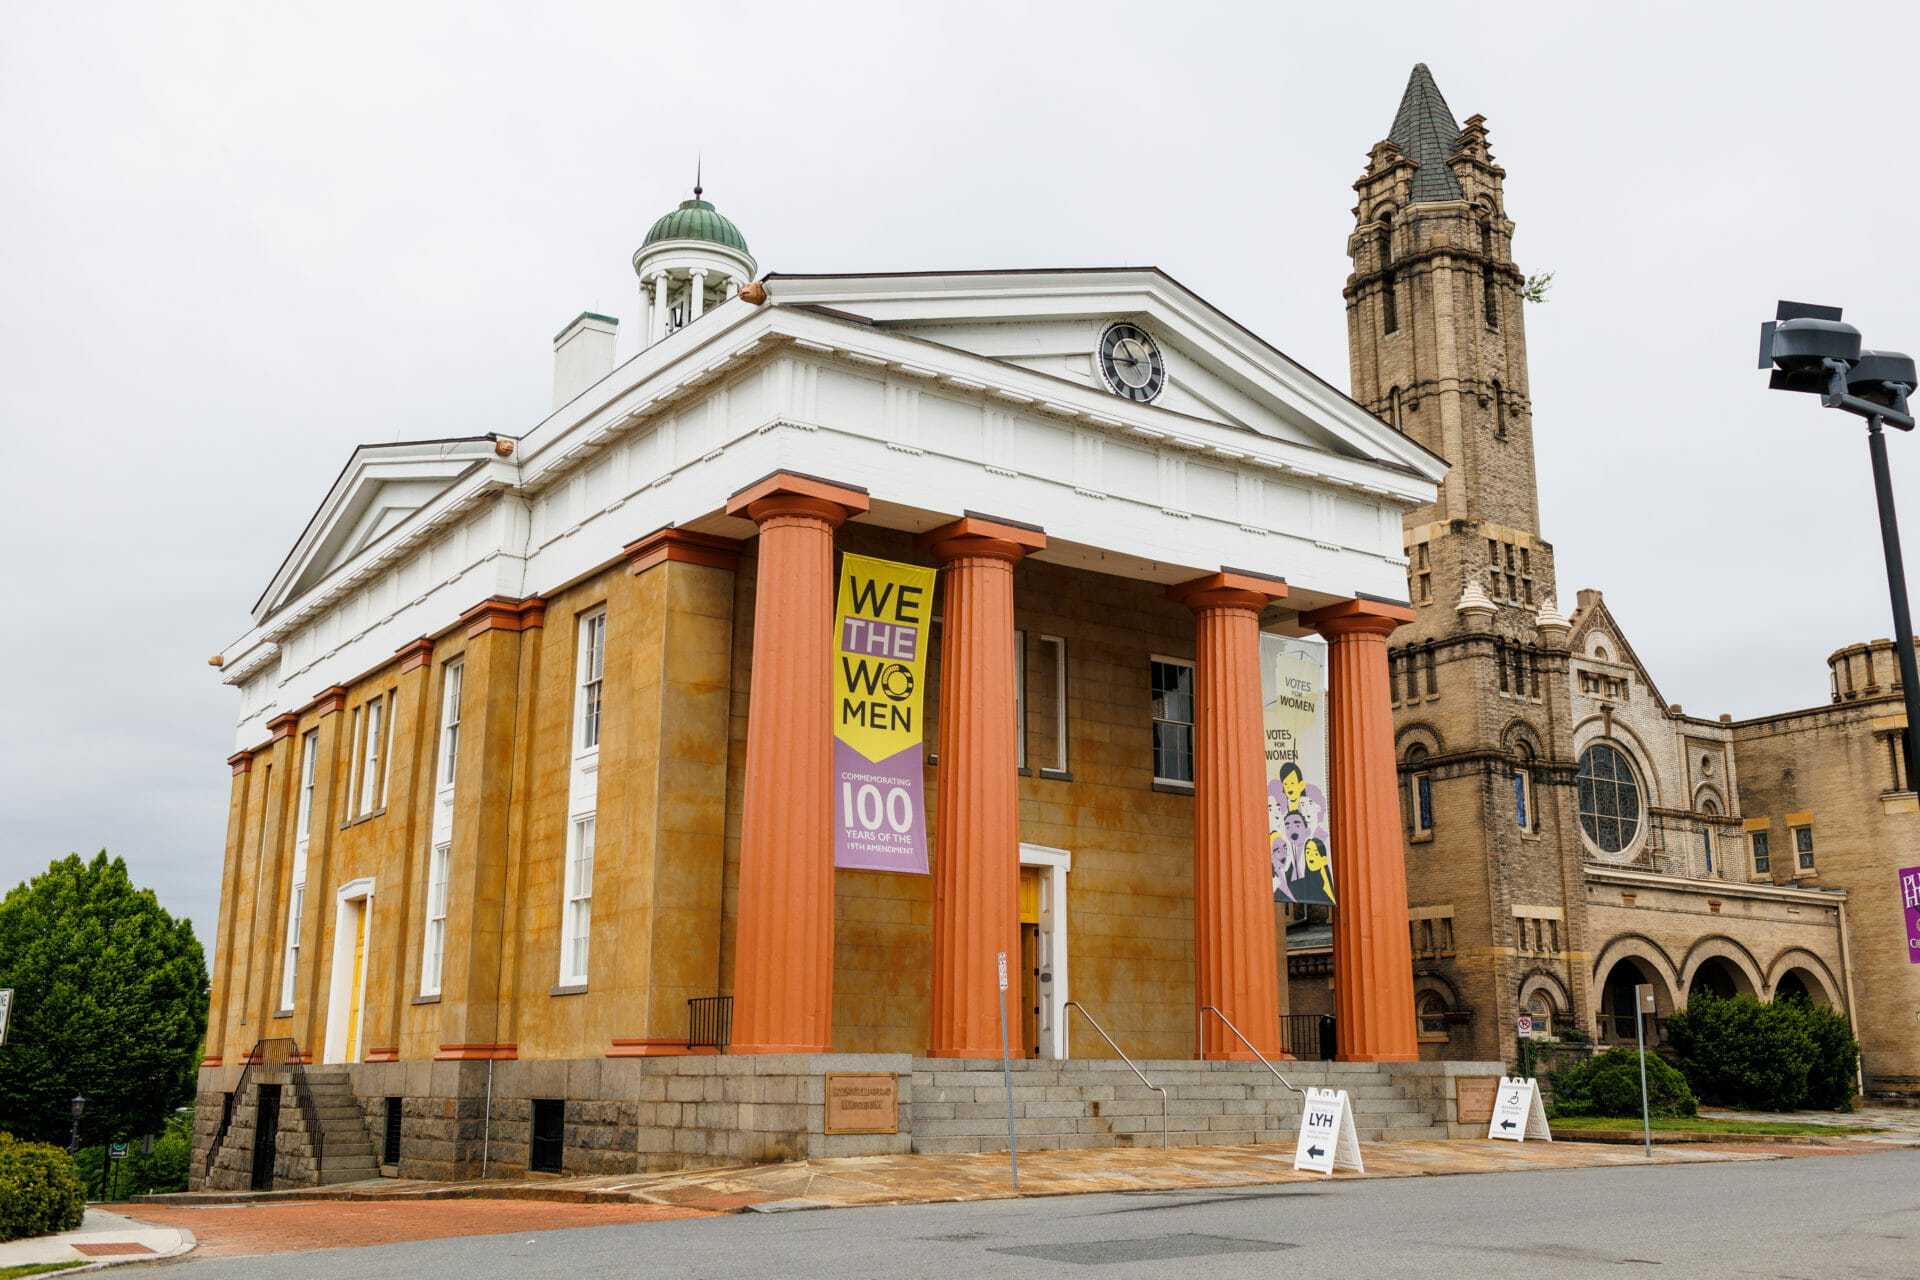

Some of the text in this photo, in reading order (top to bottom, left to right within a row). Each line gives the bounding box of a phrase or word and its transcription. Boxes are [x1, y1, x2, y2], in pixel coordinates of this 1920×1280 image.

[851, 576, 923, 624] WE
[845, 618, 916, 659] THE
[1285, 677, 1311, 693] VOTES
[1280, 695, 1315, 713] WOMEN
[843, 698, 911, 733] MEN
[1266, 729, 1292, 740] VOTES
[1265, 750, 1299, 761] WOMEN
[841, 772, 911, 787] COMMEMORATING
[843, 782, 913, 833] 100
[845, 829, 912, 844] YEARS OF THE
[847, 842, 914, 855] 19TH AMENDMENT
[1309, 1112, 1334, 1128] LYH
